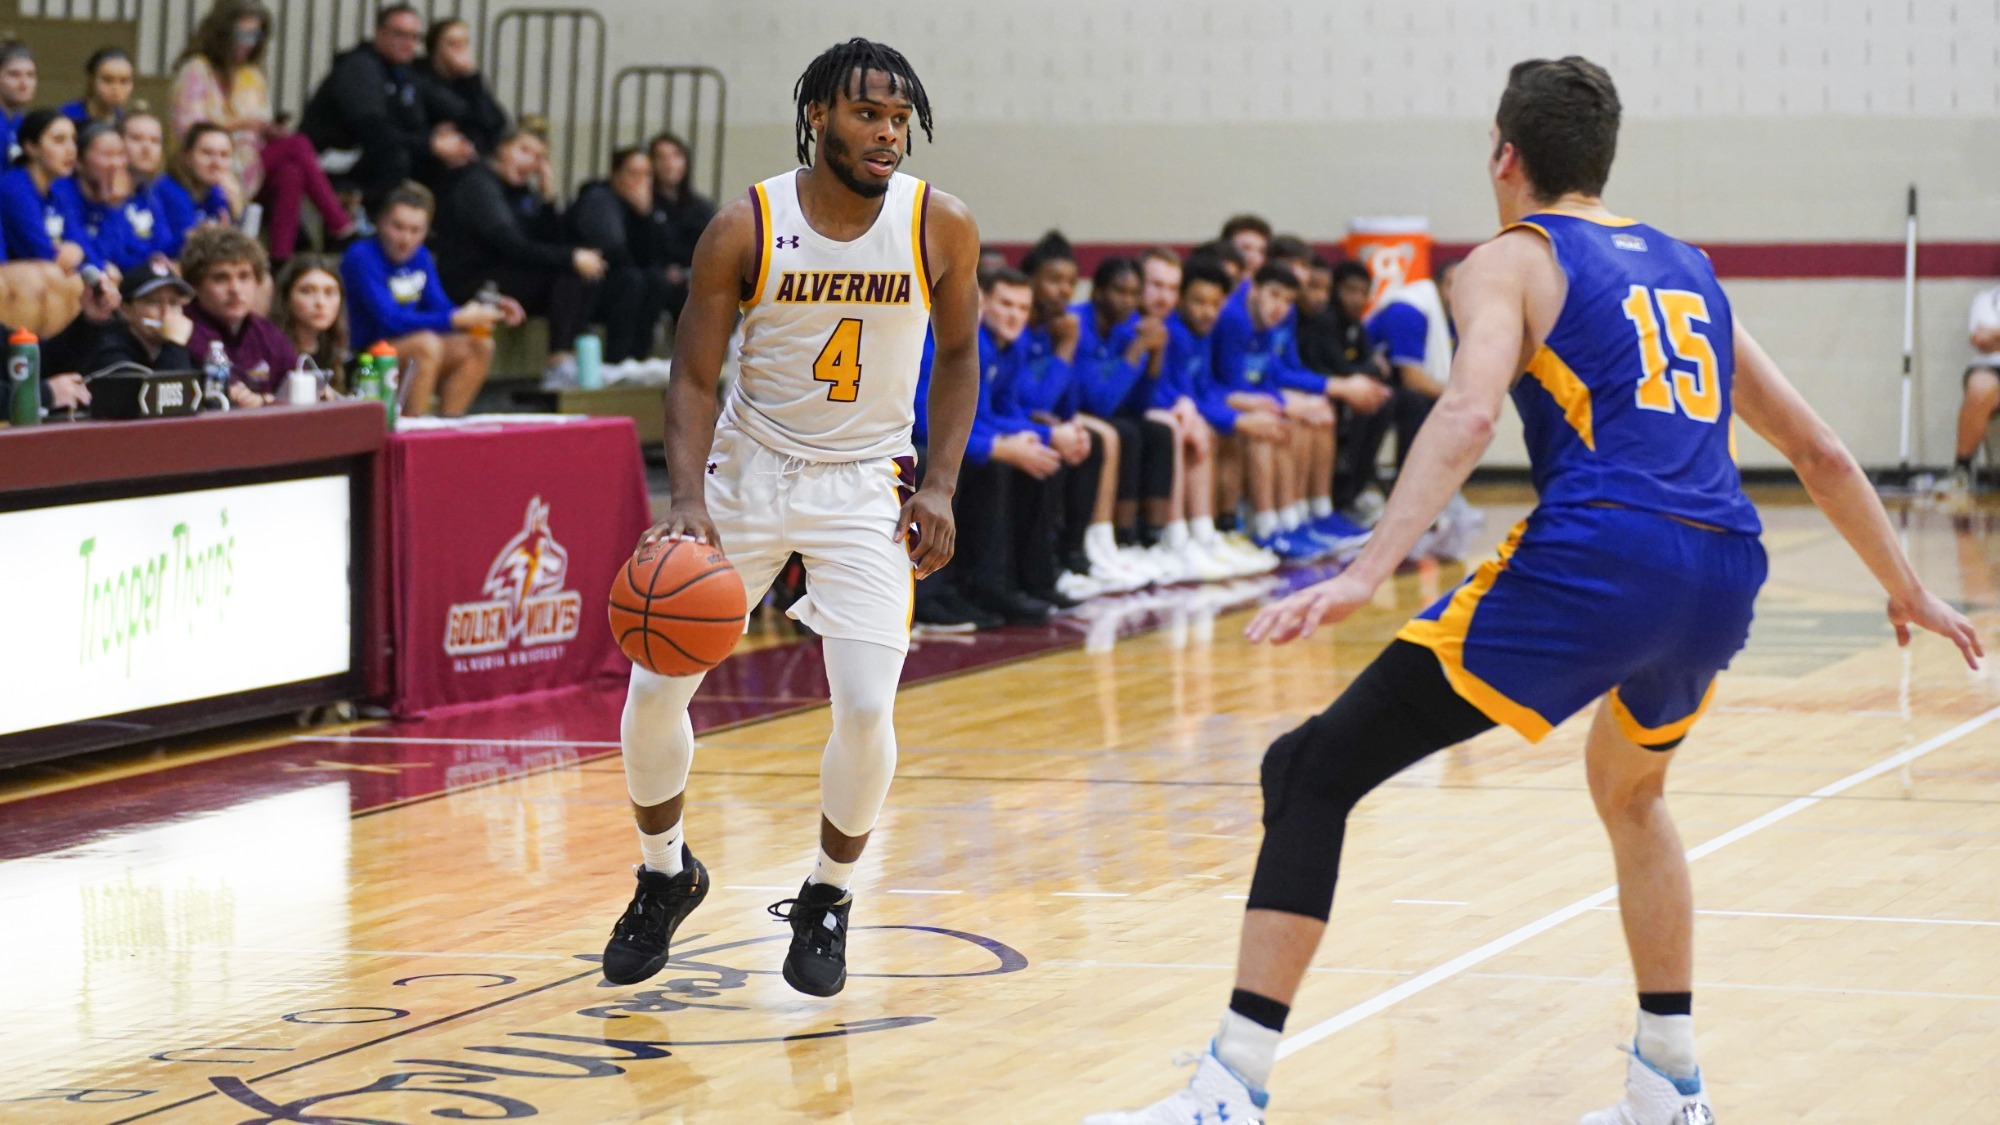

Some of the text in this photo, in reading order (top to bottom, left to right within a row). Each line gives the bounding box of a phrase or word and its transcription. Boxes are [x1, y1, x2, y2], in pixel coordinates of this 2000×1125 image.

[774, 270, 912, 306] ALVERNIA
[812, 317, 863, 402] 4
[1621, 284, 1722, 424] 15
[79, 536, 168, 680] Trooper
